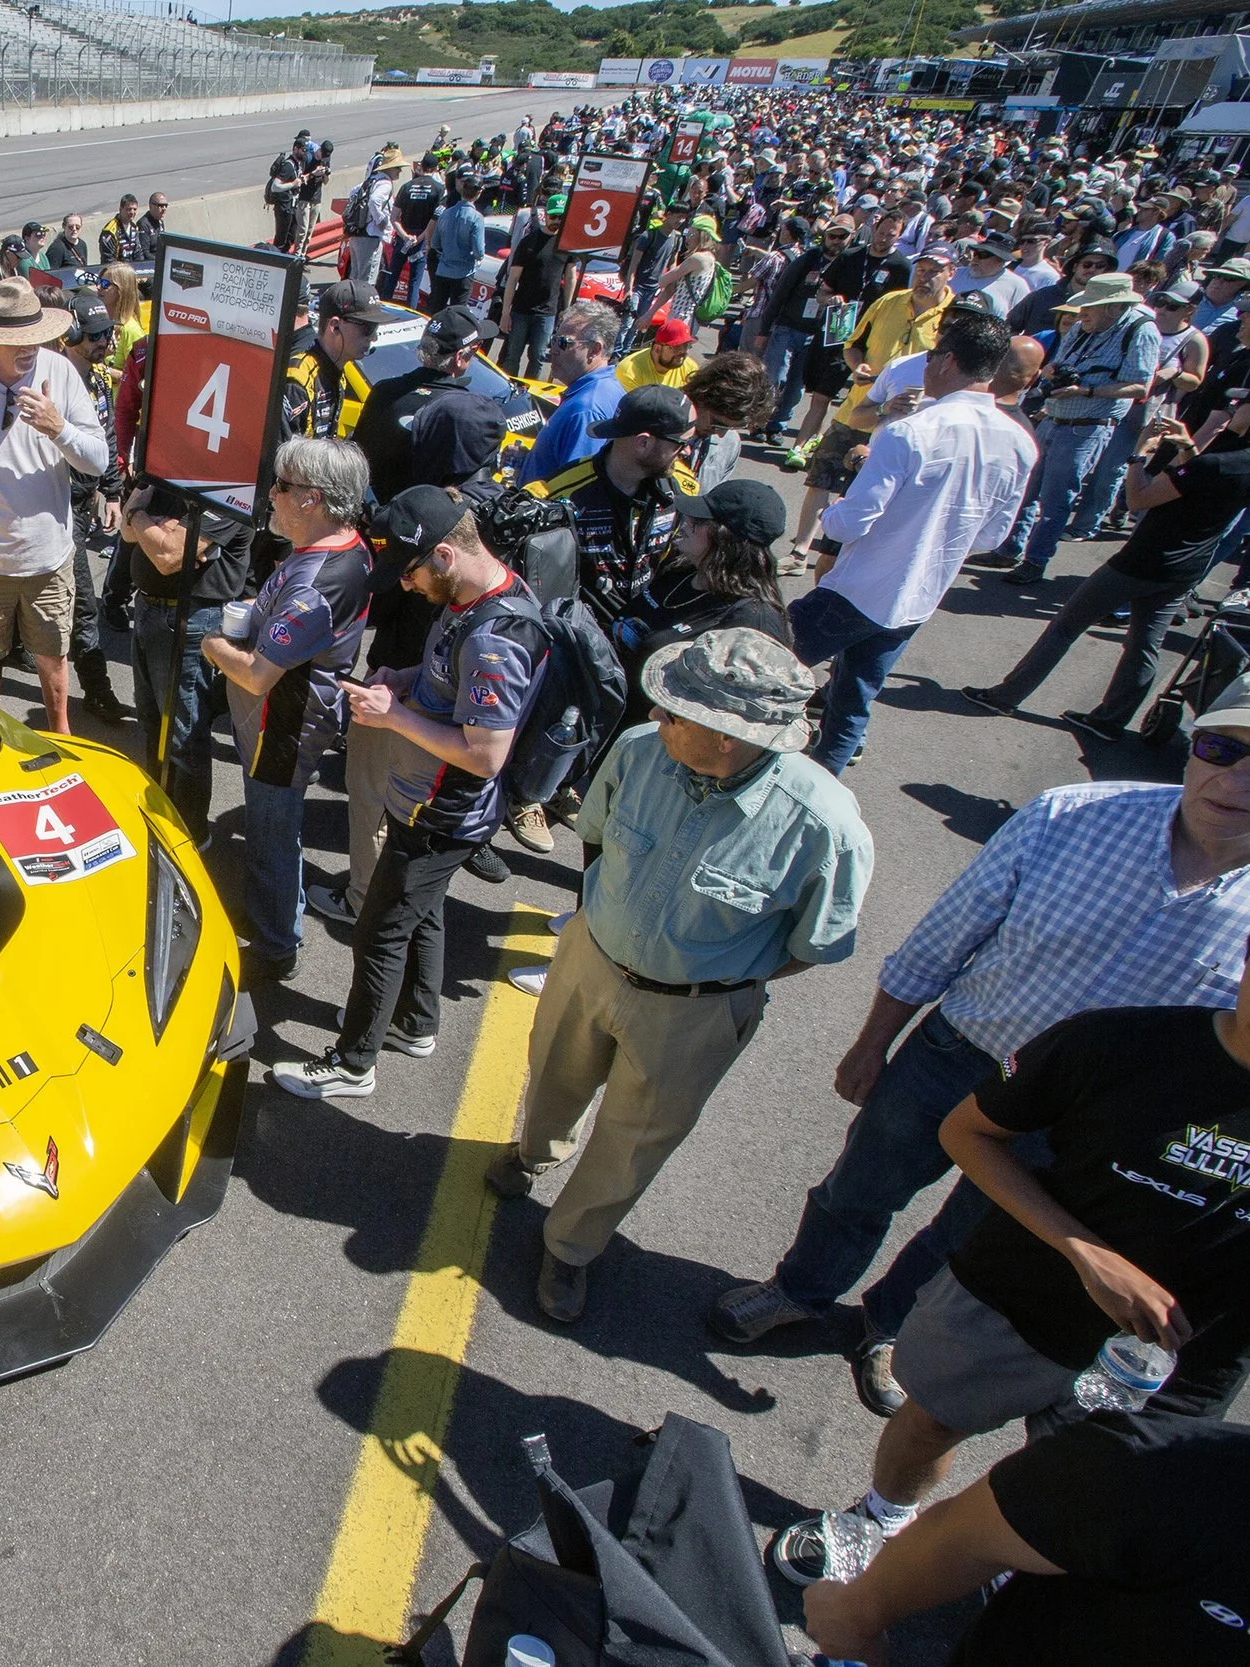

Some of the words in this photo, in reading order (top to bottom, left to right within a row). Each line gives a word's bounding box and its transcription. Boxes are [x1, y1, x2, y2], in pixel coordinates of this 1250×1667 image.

[729, 66, 772, 78] MOTUL
[677, 138, 694, 157] 14
[583, 199, 611, 237] 3
[222, 262, 270, 281] CORVETTE
[222, 273, 255, 289] RACING
[255, 280, 269, 291] BY
[214, 282, 242, 297] PRATT
[242, 287, 275, 304] MILLER
[477, 285, 488, 301] 9
[211, 292, 276, 316] MOTORSPORTS
[168, 309, 188, 320] GTD
[187, 313, 208, 325] PRO
[216, 320, 225, 329] GT
[225, 321, 254, 336] DAYTONA
[253, 329, 267, 341] PRO
[186, 362, 230, 453] 4
[506, 410, 541, 432] OSHKOSH
[234, 499, 252, 512] IMSA
[471, 686, 491, 705] VP
[35, 804, 76, 846] 4
[10, 1053, 36, 1079] 1
[1188, 1126, 1250, 1165] VASS
[1112, 1161, 1207, 1207] LEXUS
